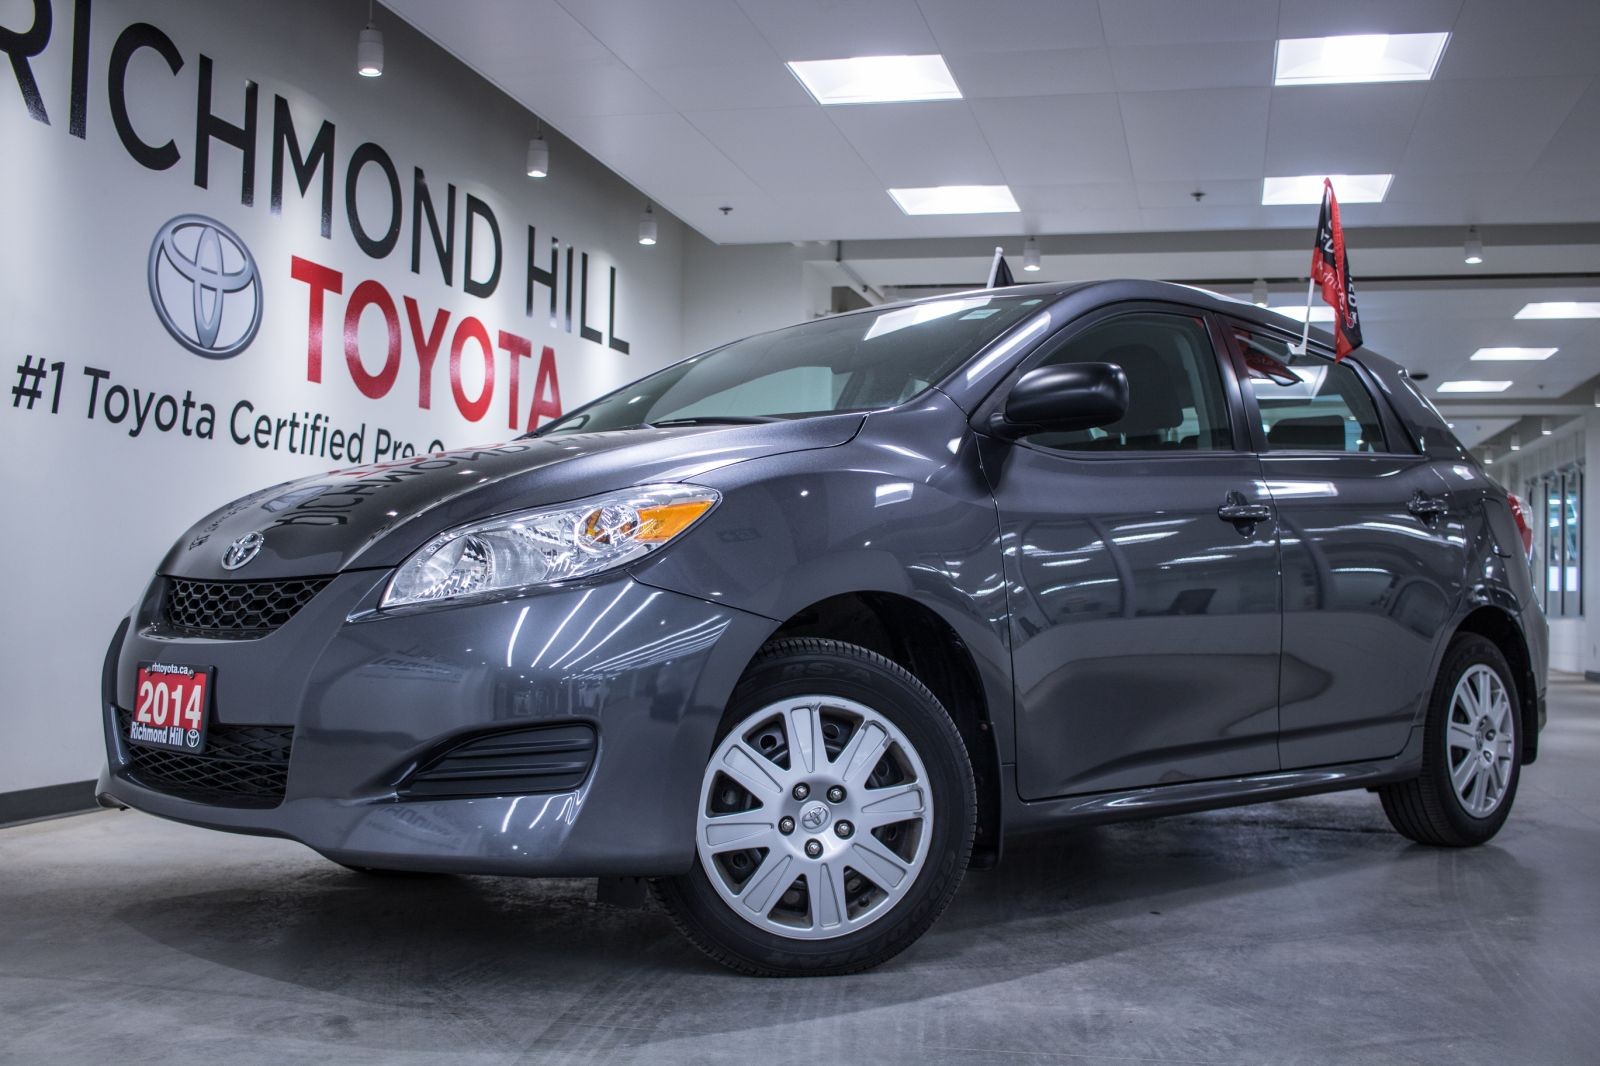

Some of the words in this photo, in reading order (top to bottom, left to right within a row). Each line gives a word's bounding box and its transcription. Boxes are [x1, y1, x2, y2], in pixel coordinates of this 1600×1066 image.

[0, 0, 502, 298] RICHMOND
[527, 225, 629, 355] HILL
[291, 255, 562, 433] TOYOTA
[12, 355, 65, 414] #1
[84, 366, 216, 440] Toyota
[230, 400, 366, 464] Certified
[137, 680, 202, 729] 2014
[152, 662, 189, 675] rhtoyota.ca
[130, 721, 168, 743] Richmond
[169, 726, 184, 746] Hill
